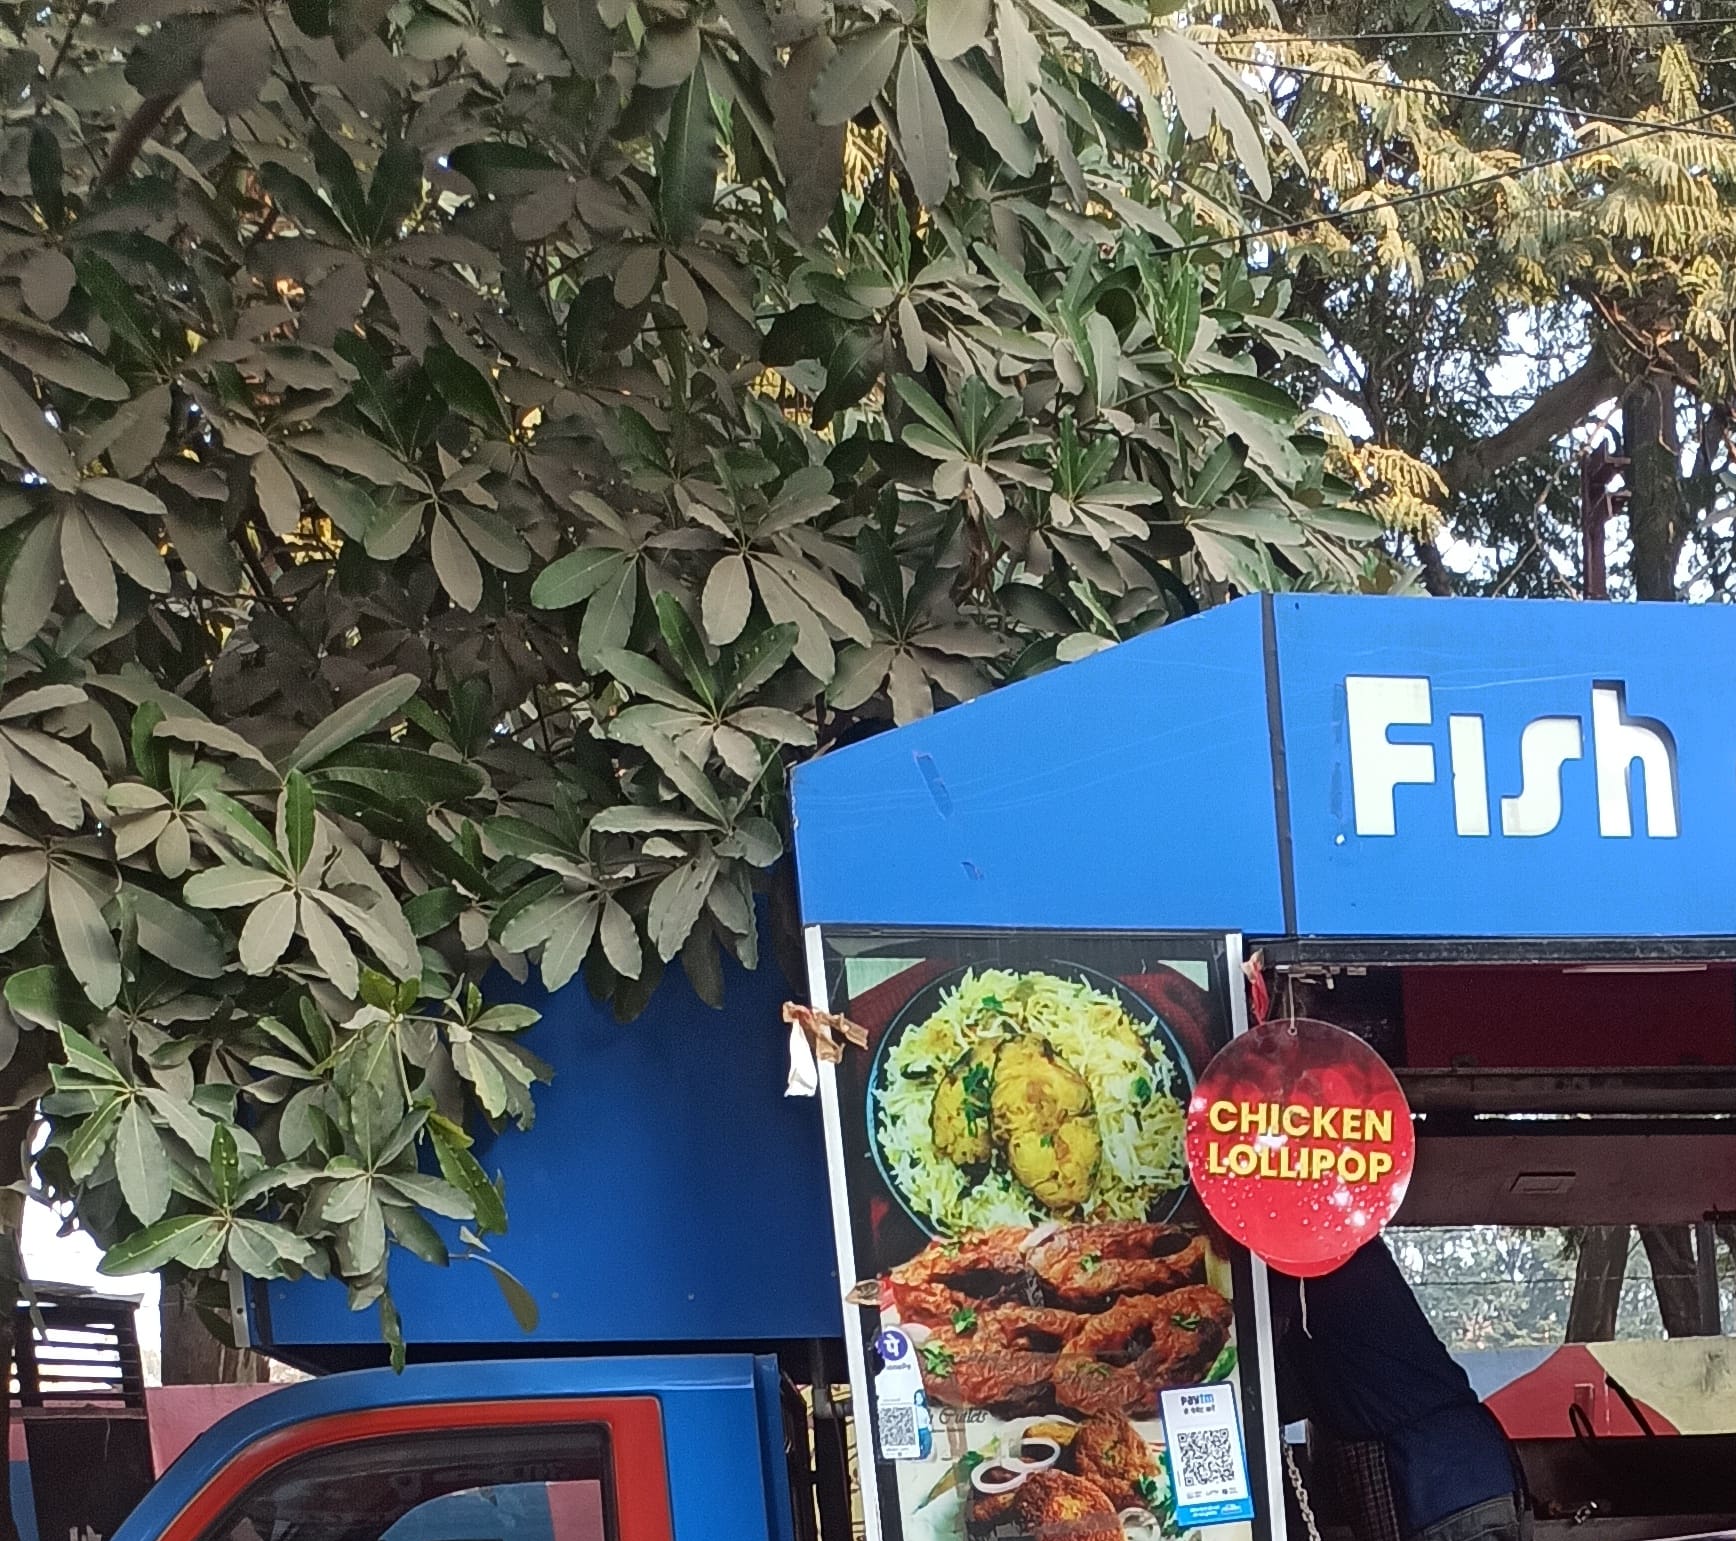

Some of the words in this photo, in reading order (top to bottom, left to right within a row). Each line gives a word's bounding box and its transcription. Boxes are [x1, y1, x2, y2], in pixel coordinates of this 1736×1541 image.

[1345, 675, 1680, 839] Fish
[1208, 1100, 1393, 1142] CHICKEN
[1208, 1142, 1393, 1184] LOLLIPOP
